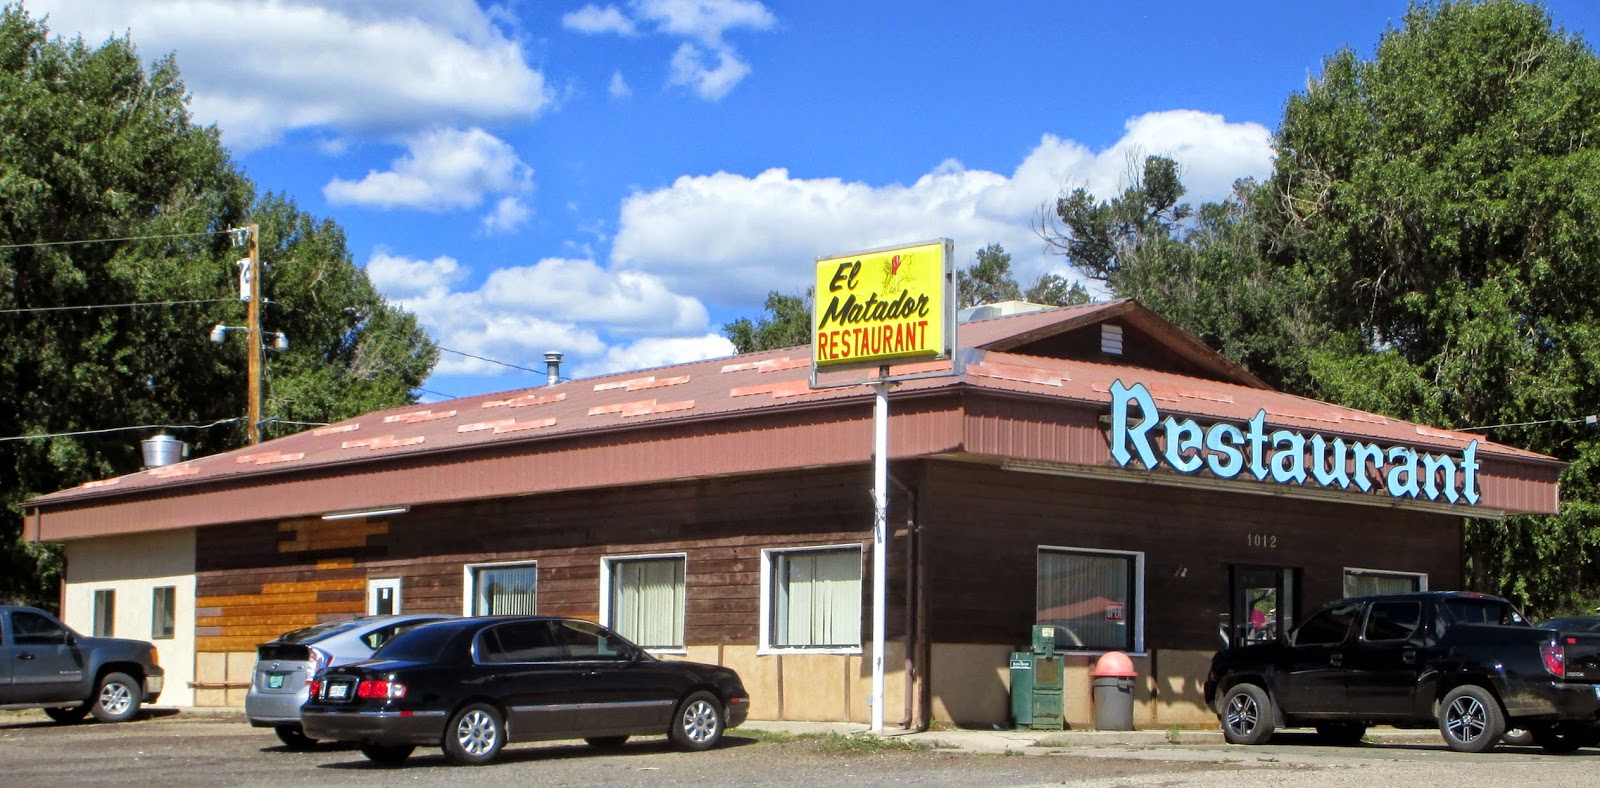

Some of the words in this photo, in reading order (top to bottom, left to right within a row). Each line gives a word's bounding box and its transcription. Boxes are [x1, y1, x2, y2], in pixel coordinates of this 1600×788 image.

[829, 260, 861, 292] El
[818, 289, 929, 330] Matador
[818, 320, 928, 360] RESTAURANT
[1109, 378, 1481, 505] Restaurant
[1247, 533, 1277, 548] 1012
